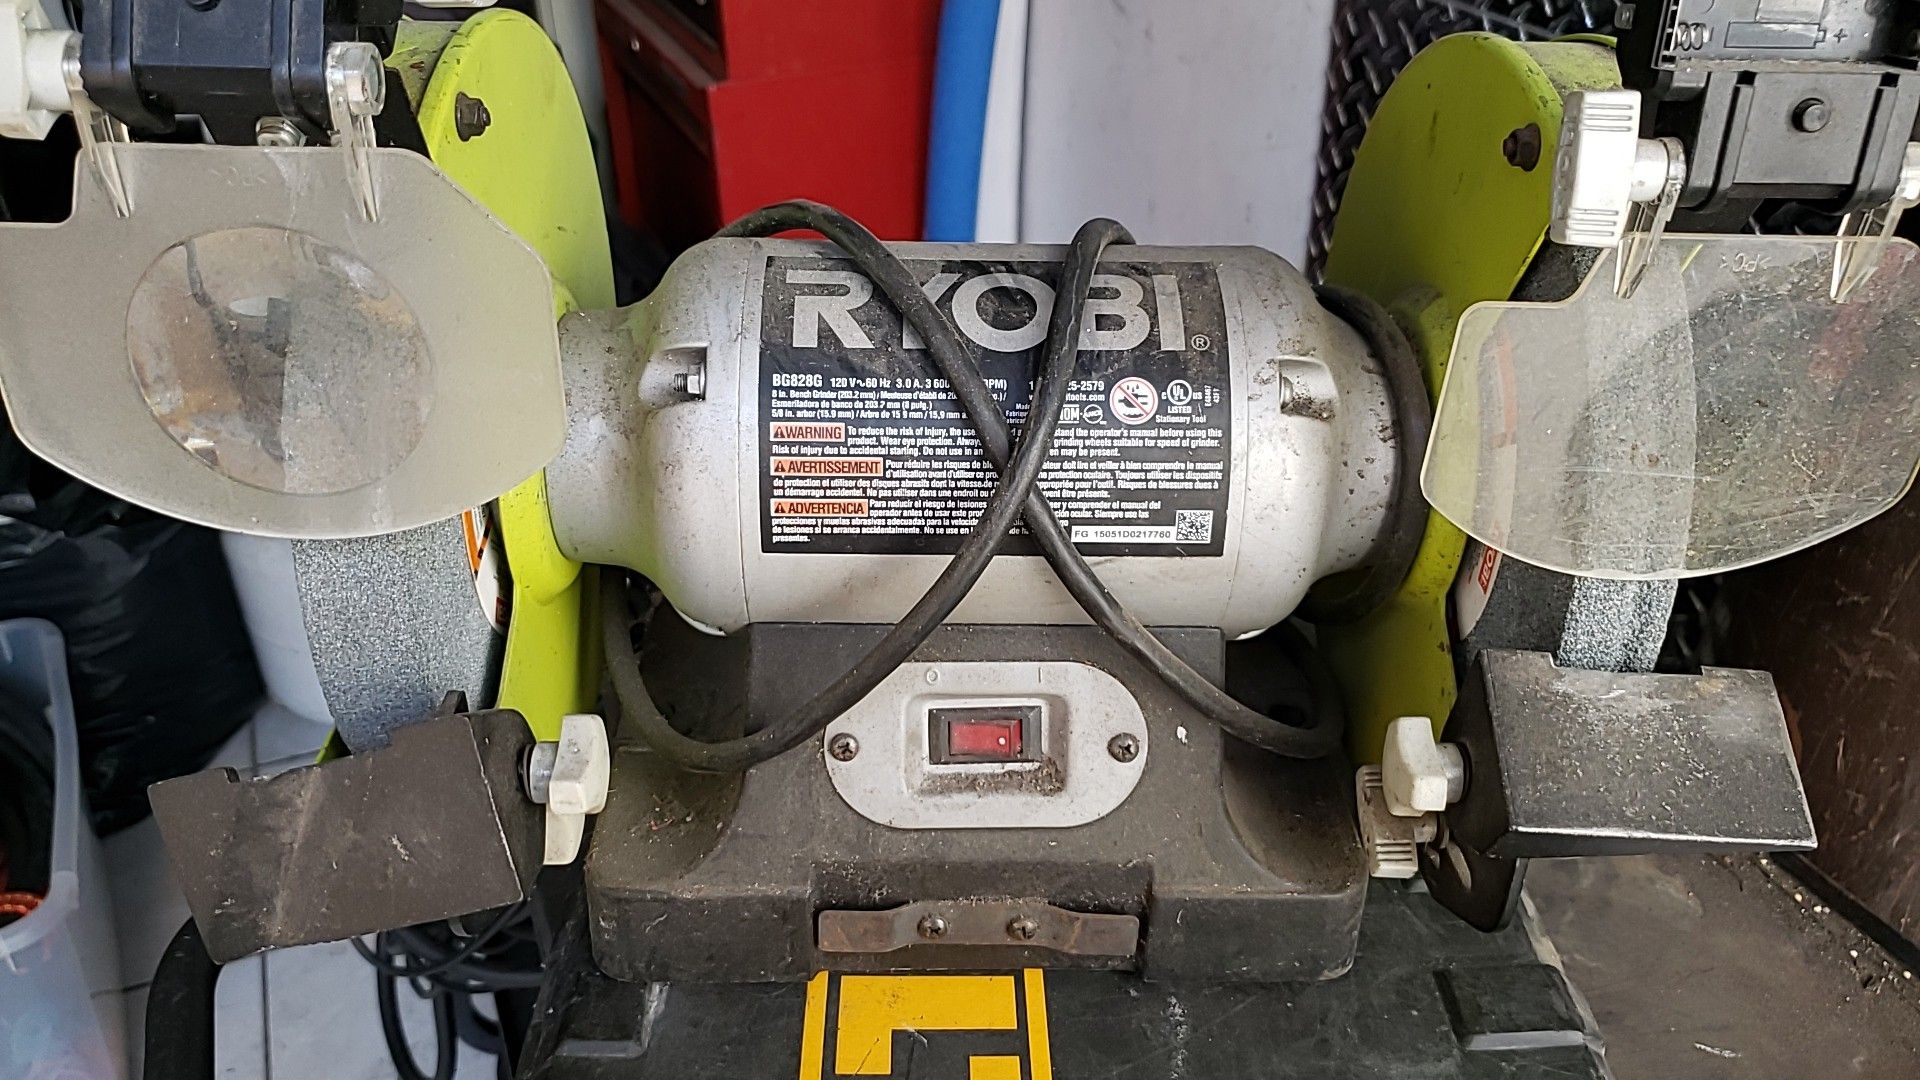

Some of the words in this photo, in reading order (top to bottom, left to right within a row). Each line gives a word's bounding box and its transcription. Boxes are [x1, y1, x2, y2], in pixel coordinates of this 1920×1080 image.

[772, 374, 823, 387] BG828G
[830, 378, 847, 388] 120
[880, 378, 891, 388] Hz
[896, 378, 911, 388] 3.0
[790, 390, 812, 399] Bench
[812, 390, 837, 399] Grinder
[860, 391, 876, 400] mm)
[1172, 385, 1187, 400] UL
[910, 401, 932, 410] pulg.)
[772, 409, 783, 417] 5/8
[797, 410, 816, 418] arbor
[817, 410, 836, 419] (15.9
[838, 410, 854, 419] mm)
[1156, 415, 1190, 424] Stationary
[785, 426, 842, 439] WARNING
[848, 426, 856, 435] To
[858, 427, 884, 436] reduce
[885, 427, 898, 436] the
[900, 427, 914, 436] risk
[915, 427, 924, 436] of
[925, 427, 948, 437] injury,
[949, 427, 962, 436] the
[1076, 428, 1088, 437] the
[1090, 428, 1128, 438] operator's
[1130, 428, 1158, 437] manual
[1160, 428, 1184, 437] before
[1185, 429, 1206, 438] using
[1207, 428, 1222, 437] this
[847, 437, 878, 446] product.
[880, 437, 901, 446] Wear
[902, 438, 915, 447] eye
[917, 437, 955, 446] protection.
[1054, 438, 1083, 447] grinding
[1085, 438, 1112, 447] wheels
[1113, 438, 1143, 447] suitable
[1145, 438, 1155, 447] for
[1157, 439, 1180, 448] speed
[1182, 439, 1190, 447] of
[1191, 439, 1220, 448] grinder.
[772, 445, 789, 454] Risk
[791, 445, 799, 454] of
[800, 445, 822, 455] injury
[824, 446, 838, 454] due
[840, 446, 847, 454] to
[849, 446, 888, 455] accidental
[890, 446, 921, 456] starting.
[923, 447, 934, 455] Do
[935, 447, 947, 455] not
[964, 447, 972, 455] in
[1060, 449, 1077, 458] may
[1079, 448, 1088, 456] be
[1090, 448, 1121, 457] present.
[788, 461, 881, 474] AVERTISSEMENT
[886, 460, 903, 468] Pour
[904, 460, 930, 468] réduire
[932, 460, 942, 468] les
[944, 460, 970, 470] risques
[972, 460, 980, 468] de
[1062, 461, 1076, 469] doit
[1098, 461, 1119, 469] veiller
[1126, 461, 1141, 469] bien
[1142, 461, 1185, 471] comprendre
[1187, 461, 1194, 469] le
[886, 470, 927, 478] d'utilisation
[928, 470, 946, 478] avant
[947, 470, 975, 478] d'utiliser
[1048, 471, 1082, 480] protection
[1083, 471, 1113, 479] oculaire.
[1115, 471, 1145, 480] Toujours
[1147, 471, 1172, 479] utiliser
[1173, 471, 1184, 479] les
[1185, 471, 1222, 480] dispositifs
[773, 479, 783, 487] de
[784, 479, 820, 488] protection
[831, 479, 856, 487] utiliser
[857, 479, 870, 487] des
[872, 479, 899, 489] disques
[931, 479, 947, 488] dont
[948, 479, 956, 487] la
[957, 479, 983, 488] vitesse
[1075, 481, 1092, 490] pour
[1118, 480, 1146, 490] Risques
[1148, 480, 1157, 489] de
[1158, 480, 1193, 489] blessures
[1194, 480, 1212, 489] dues
[785, 488, 824, 497] démarrage
[826, 488, 865, 496] accidentel.
[867, 488, 877, 496] Ne
[878, 489, 892, 498] pas
[893, 488, 918, 497] utiliser
[919, 489, 936, 497] dans
[953, 489, 978, 497] endroit
[1062, 489, 1076, 497] être
[1077, 489, 1111, 499] présents.
[788, 503, 864, 514] ADVERTENCIA
[869, 499, 886, 507] Para
[888, 500, 913, 508] reducir
[914, 500, 921, 508] el
[922, 500, 945, 509] riesgo
[947, 500, 955, 508] de
[957, 500, 987, 508] lesiones
[1068, 501, 1111, 511] comprender
[1121, 501, 1148, 509] manual
[1149, 501, 1161, 509] del
[869, 508, 902, 517] operador
[903, 509, 922, 517] antes
[924, 509, 933, 517] de
[952, 509, 967, 517] este
[1094, 510, 1123, 519] Siempre
[772, 518, 816, 526] protecciones
[887, 518, 925, 526] adecuadas
[927, 518, 941, 526] para
[861, 526, 922, 534] accidentalmente.
[1074, 530, 1089, 538] FG
[1094, 530, 1171, 538] 15051D0217760
[773, 535, 810, 543] presentes.
